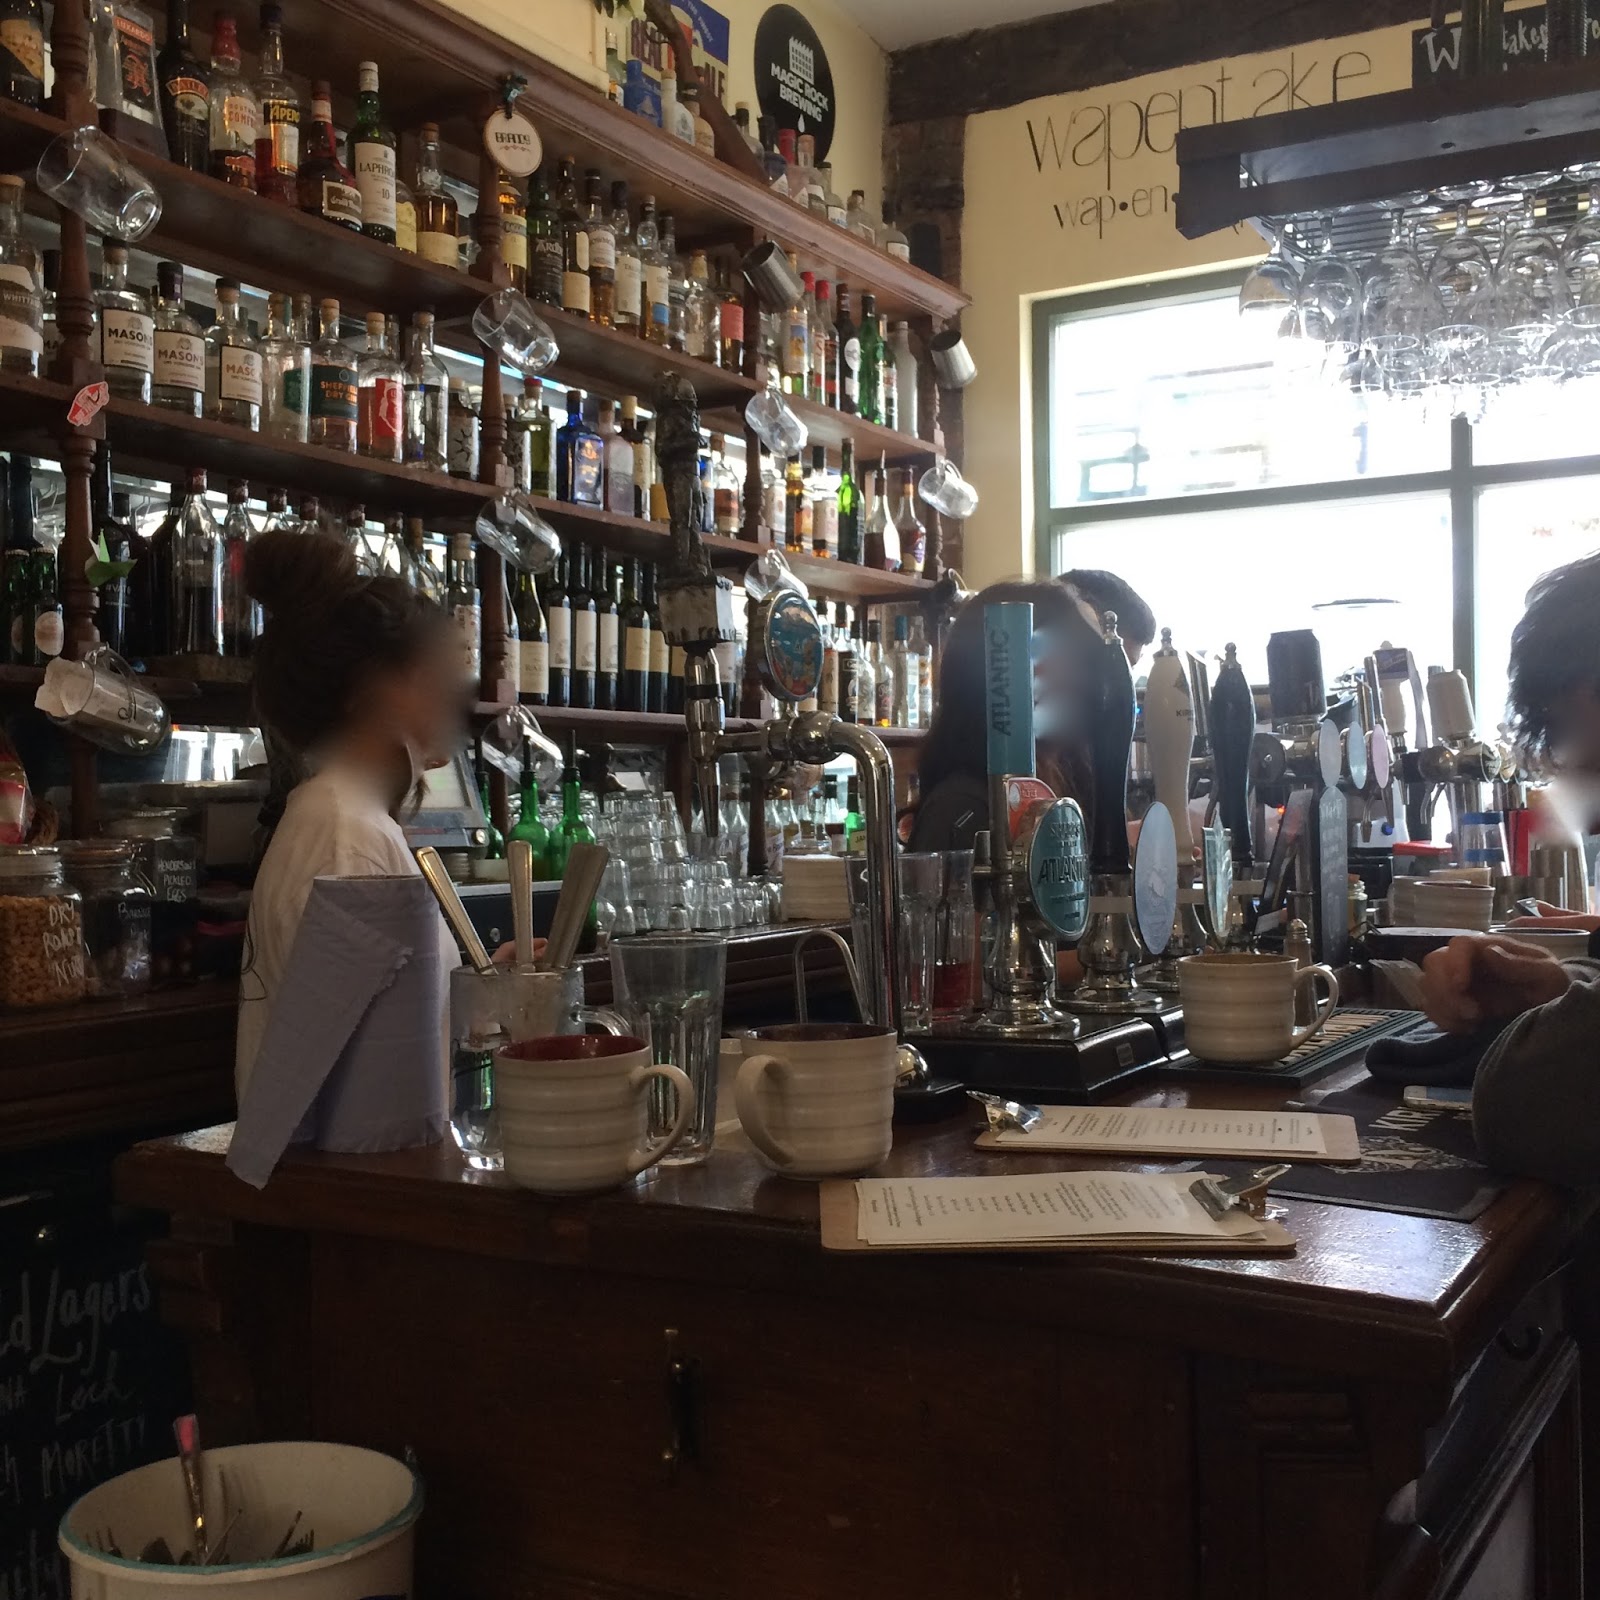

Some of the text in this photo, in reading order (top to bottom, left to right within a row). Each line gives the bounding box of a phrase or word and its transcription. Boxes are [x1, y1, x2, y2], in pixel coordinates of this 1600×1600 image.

[771, 62, 829, 112] MAGIC ROCK
[779, 83, 823, 122] BREWING
[270, 105, 300, 123] APERO
[359, 161, 396, 181] LAPHRO
[991, 628, 1010, 737] ATLANTIC
[49, 900, 75, 928] DRY
[1367, 1106, 1445, 1132] KIR
[30, 1262, 151, 1376] Lagers
